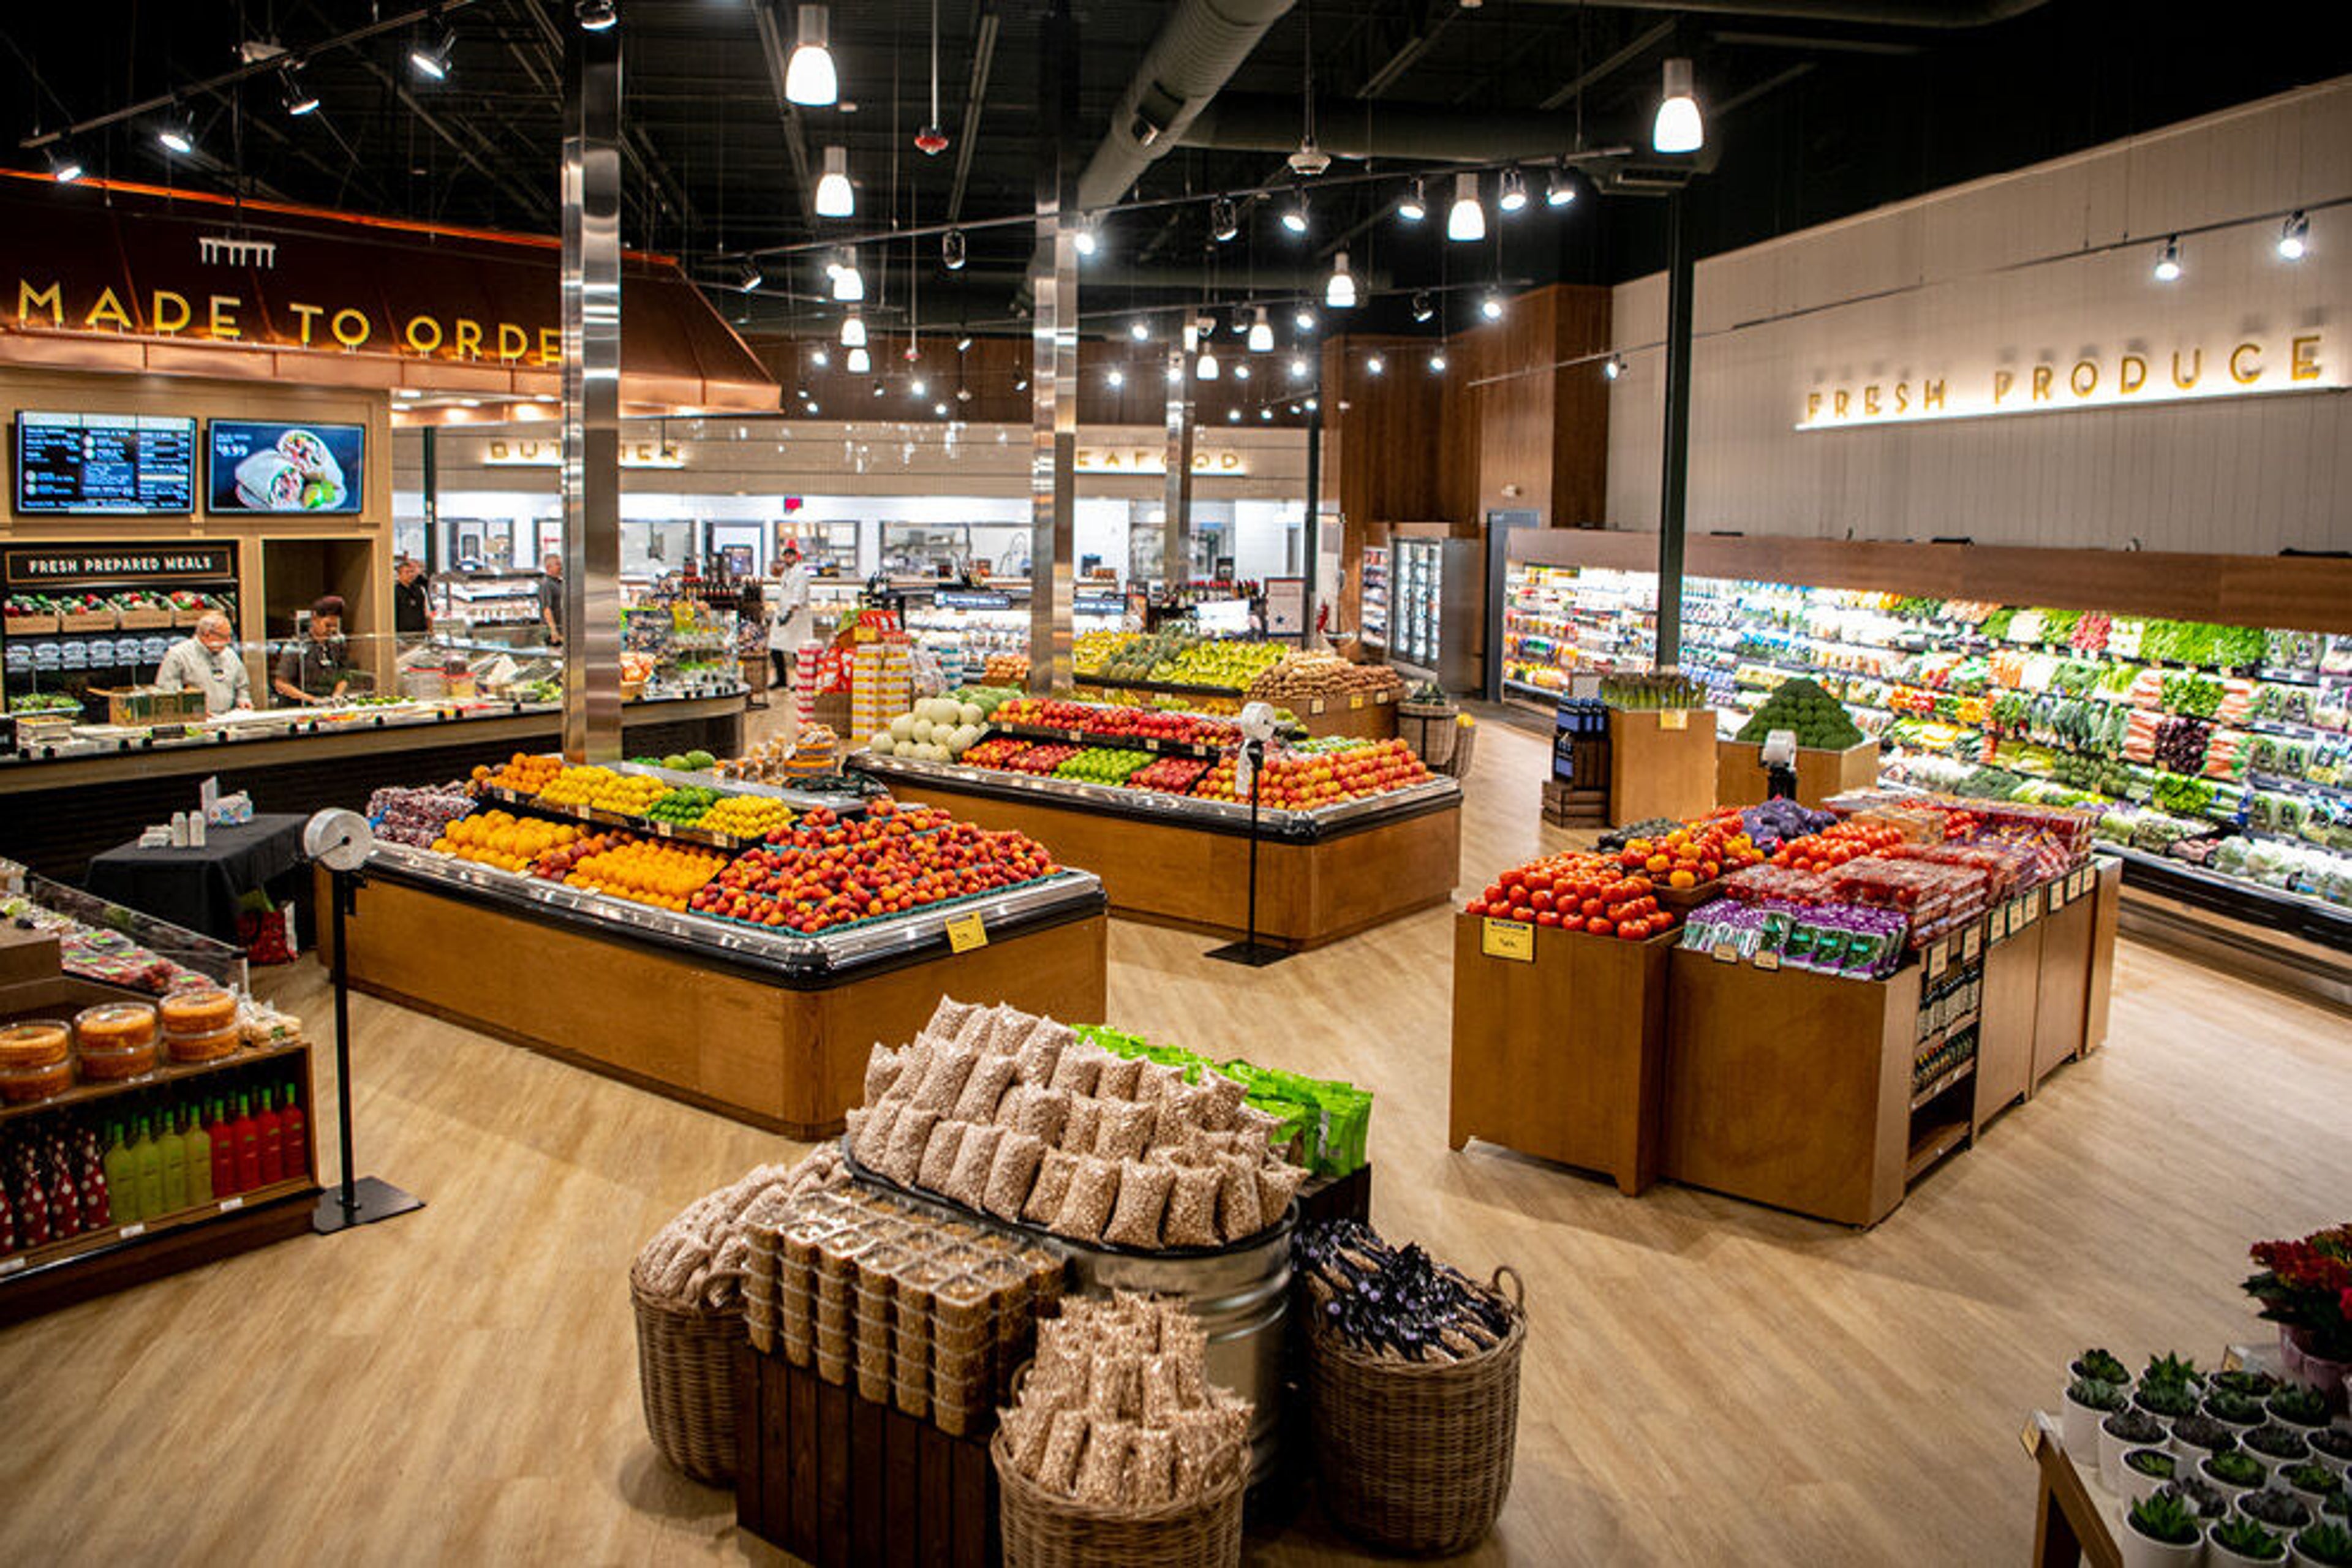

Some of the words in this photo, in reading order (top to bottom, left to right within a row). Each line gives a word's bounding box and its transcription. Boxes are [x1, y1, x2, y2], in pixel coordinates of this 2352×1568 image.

[18, 279, 241, 336] MADE
[289, 303, 370, 346] TO
[405, 315, 562, 363] ORDE
[1807, 377, 1945, 420] FRESH
[1994, 335, 2322, 404] PRODUCE
[491, 439, 678, 461] BUTER
[1077, 450, 1238, 469] EAFOD
[29, 559, 78, 573] FRESH
[85, 557, 160, 571] PREPARED
[164, 556, 213, 570] MEALS
